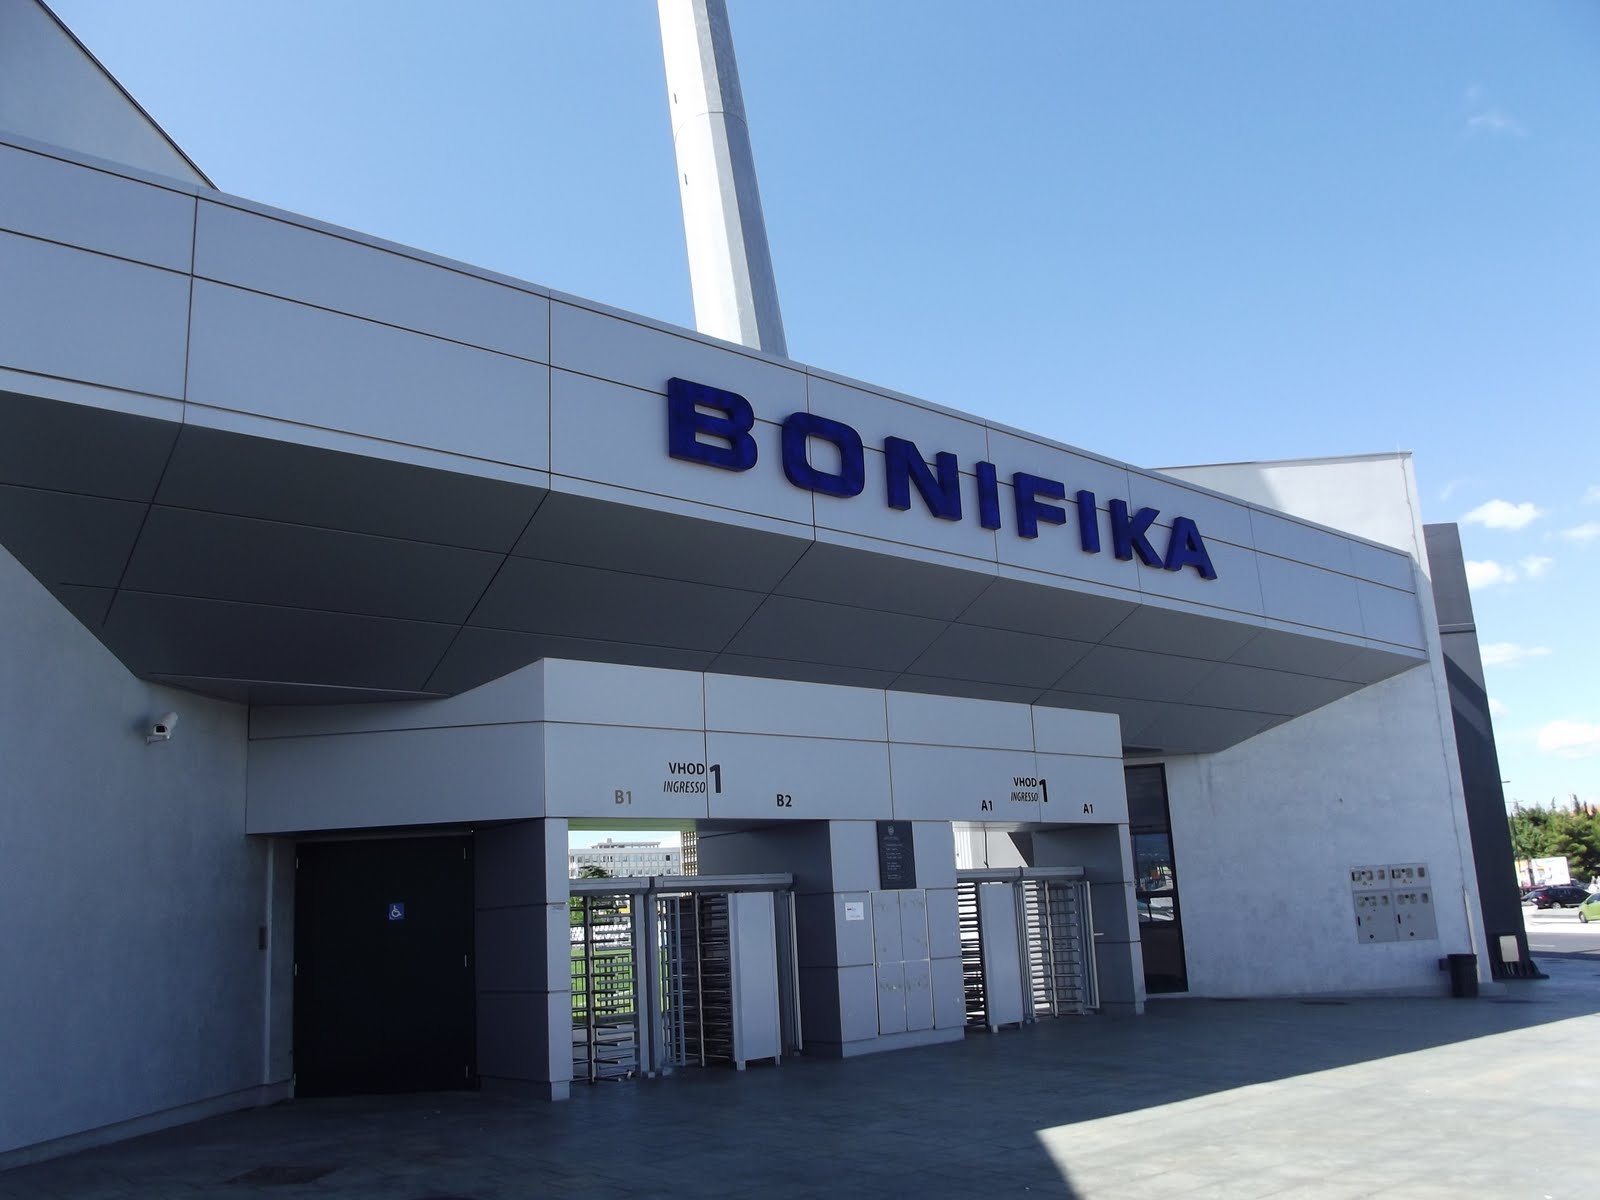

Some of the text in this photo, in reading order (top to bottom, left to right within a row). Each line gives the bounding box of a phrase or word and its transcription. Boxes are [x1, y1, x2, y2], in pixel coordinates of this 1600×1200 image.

[668, 377, 1218, 580] BONIFIKA
[668, 762, 722, 793] VHOD 1
[663, 780, 706, 793] INGRESSO
[1013, 777, 1048, 802] VHOD 1
[615, 790, 632, 804] B1
[776, 794, 792, 807] B2
[1010, 791, 1039, 802] INGRESSO
[981, 800, 993, 811] A1
[1083, 803, 1094, 814] A1
